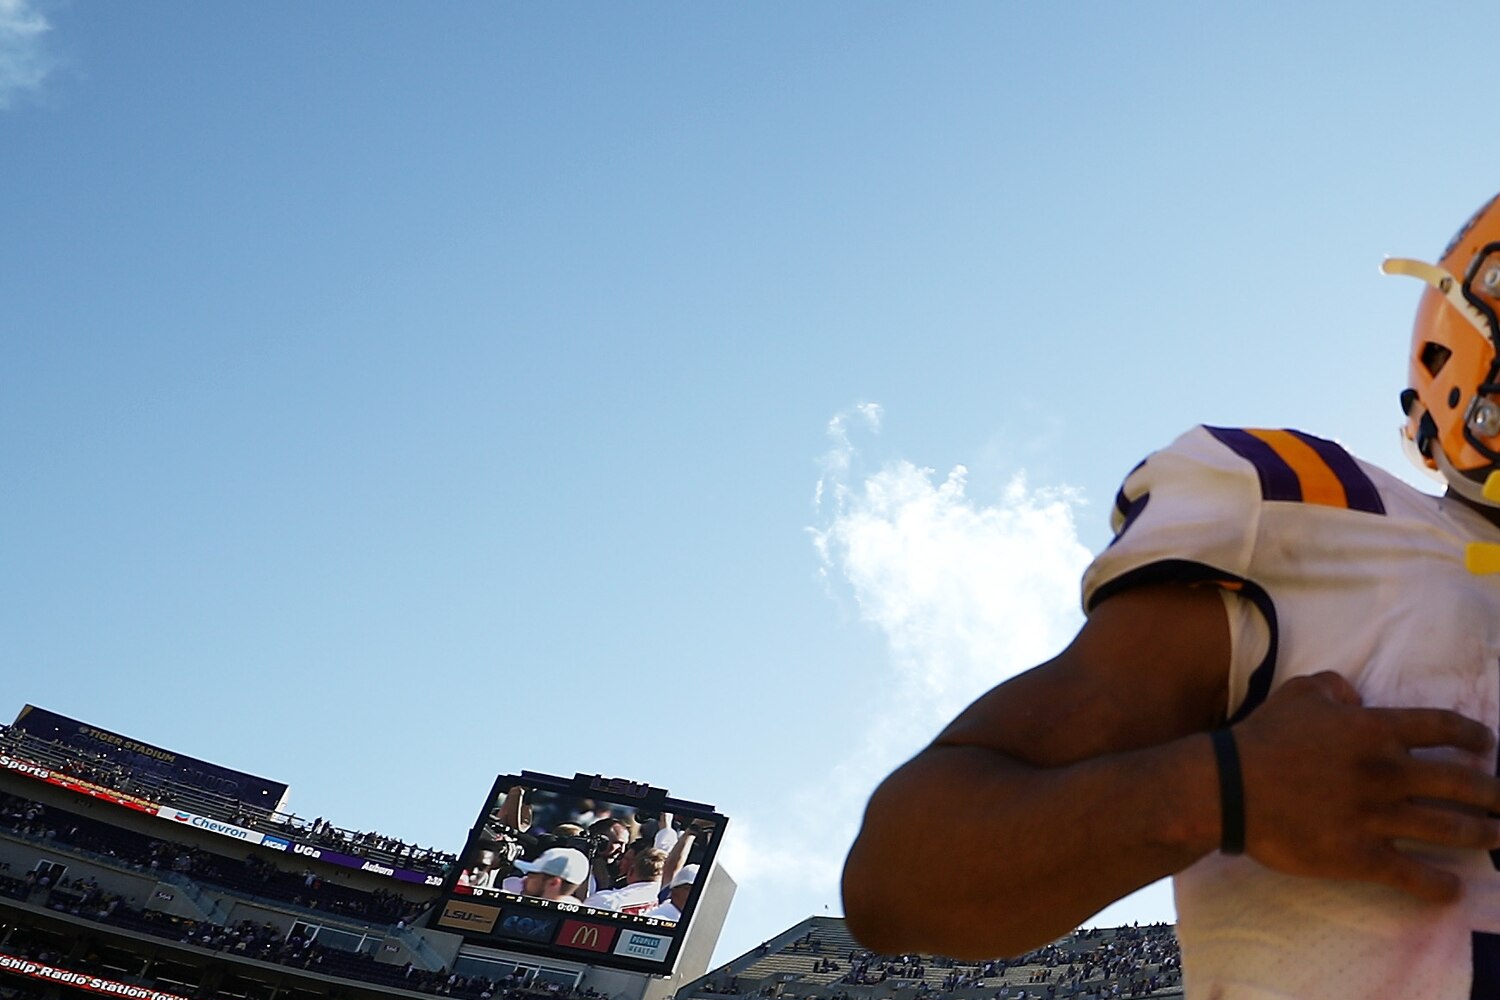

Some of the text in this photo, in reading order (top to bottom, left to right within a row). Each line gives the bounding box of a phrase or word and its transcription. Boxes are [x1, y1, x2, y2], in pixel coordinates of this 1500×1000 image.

[88, 729, 177, 763] TIGER STADIUM
[0, 755, 50, 779] Sports
[192, 817, 248, 839] Chevron
[293, 843, 321, 859] UGa
[360, 860, 394, 877] Auburn
[556, 901, 580, 913] 0:00
[39, 965, 88, 986] Radio
[89, 977, 148, 1000] Station
